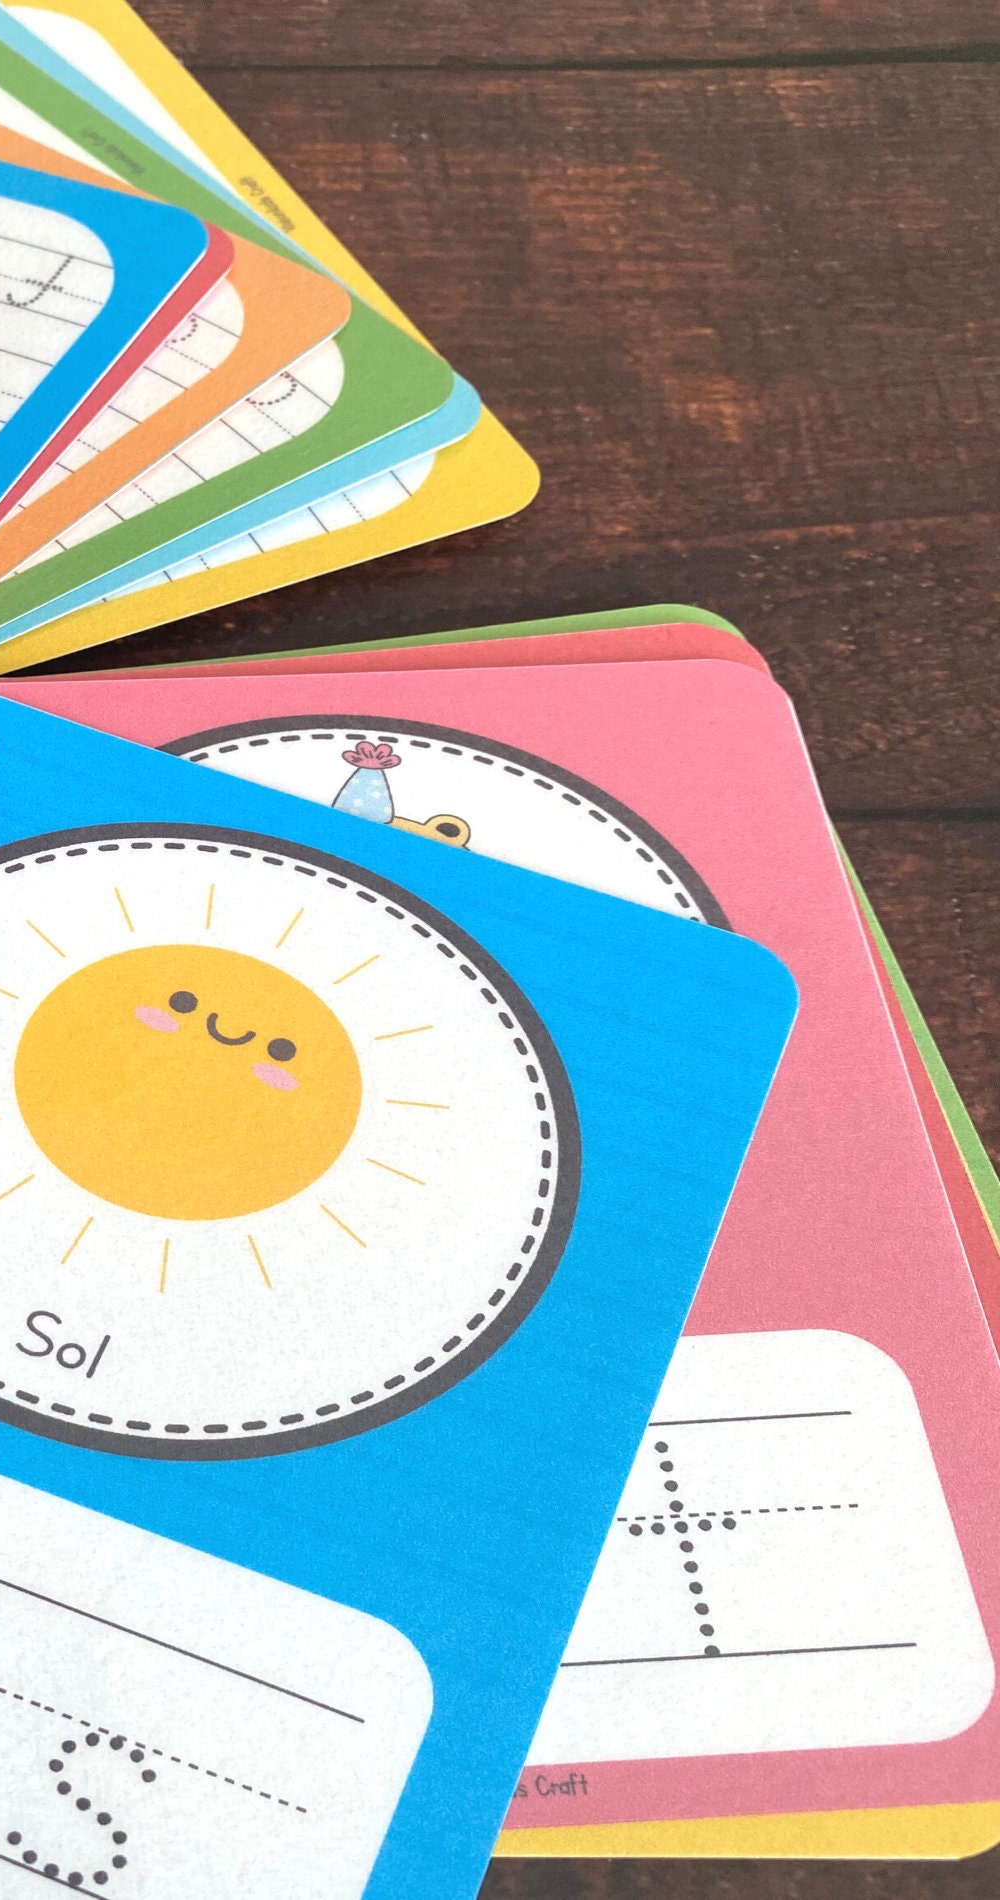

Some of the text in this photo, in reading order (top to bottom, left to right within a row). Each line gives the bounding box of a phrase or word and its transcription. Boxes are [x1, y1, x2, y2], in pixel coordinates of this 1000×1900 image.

[15, 1310, 111, 1378] Sol
[7, 1732, 157, 1886] s
[534, 1772, 589, 1797] Craft
